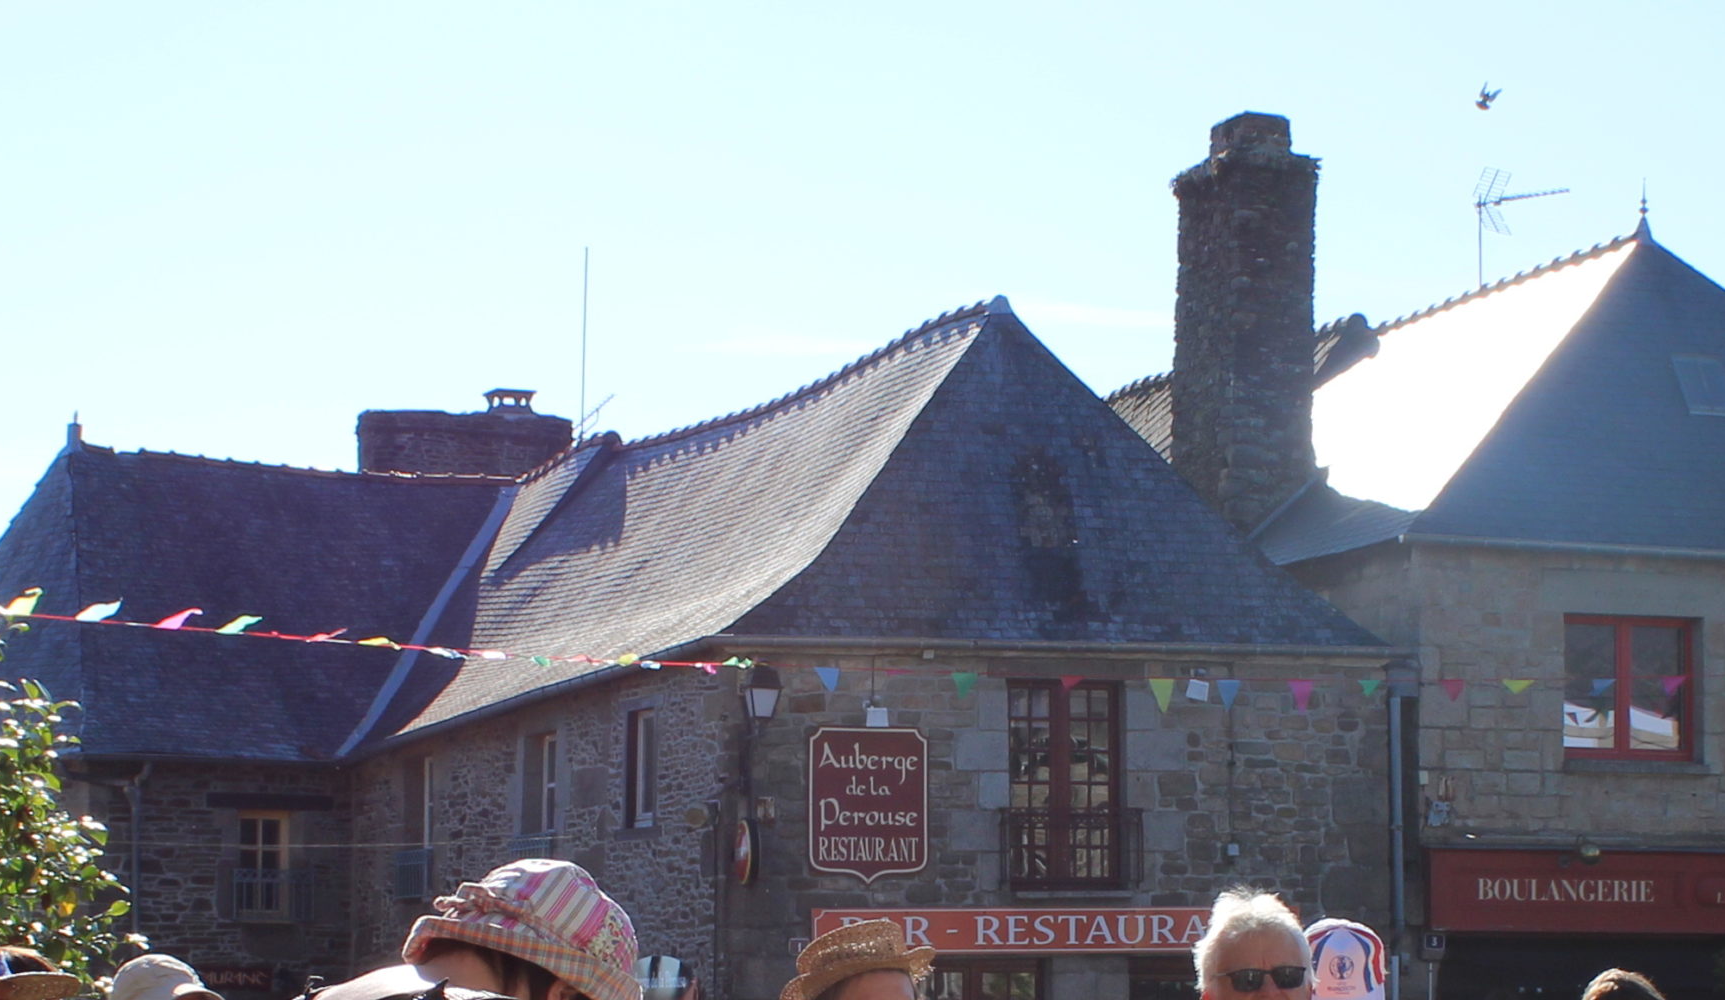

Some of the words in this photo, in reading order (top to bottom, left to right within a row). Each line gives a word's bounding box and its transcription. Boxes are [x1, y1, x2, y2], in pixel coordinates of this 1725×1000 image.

[818, 742, 919, 785] Auberge
[845, 775, 866, 796] de
[869, 776, 891, 796] la
[819, 798, 919, 831] Perouse
[818, 836, 919, 862] RESTAURANT
[1477, 878, 1655, 903] BOULANGERIE
[973, 914, 1208, 945] RESTAURA
